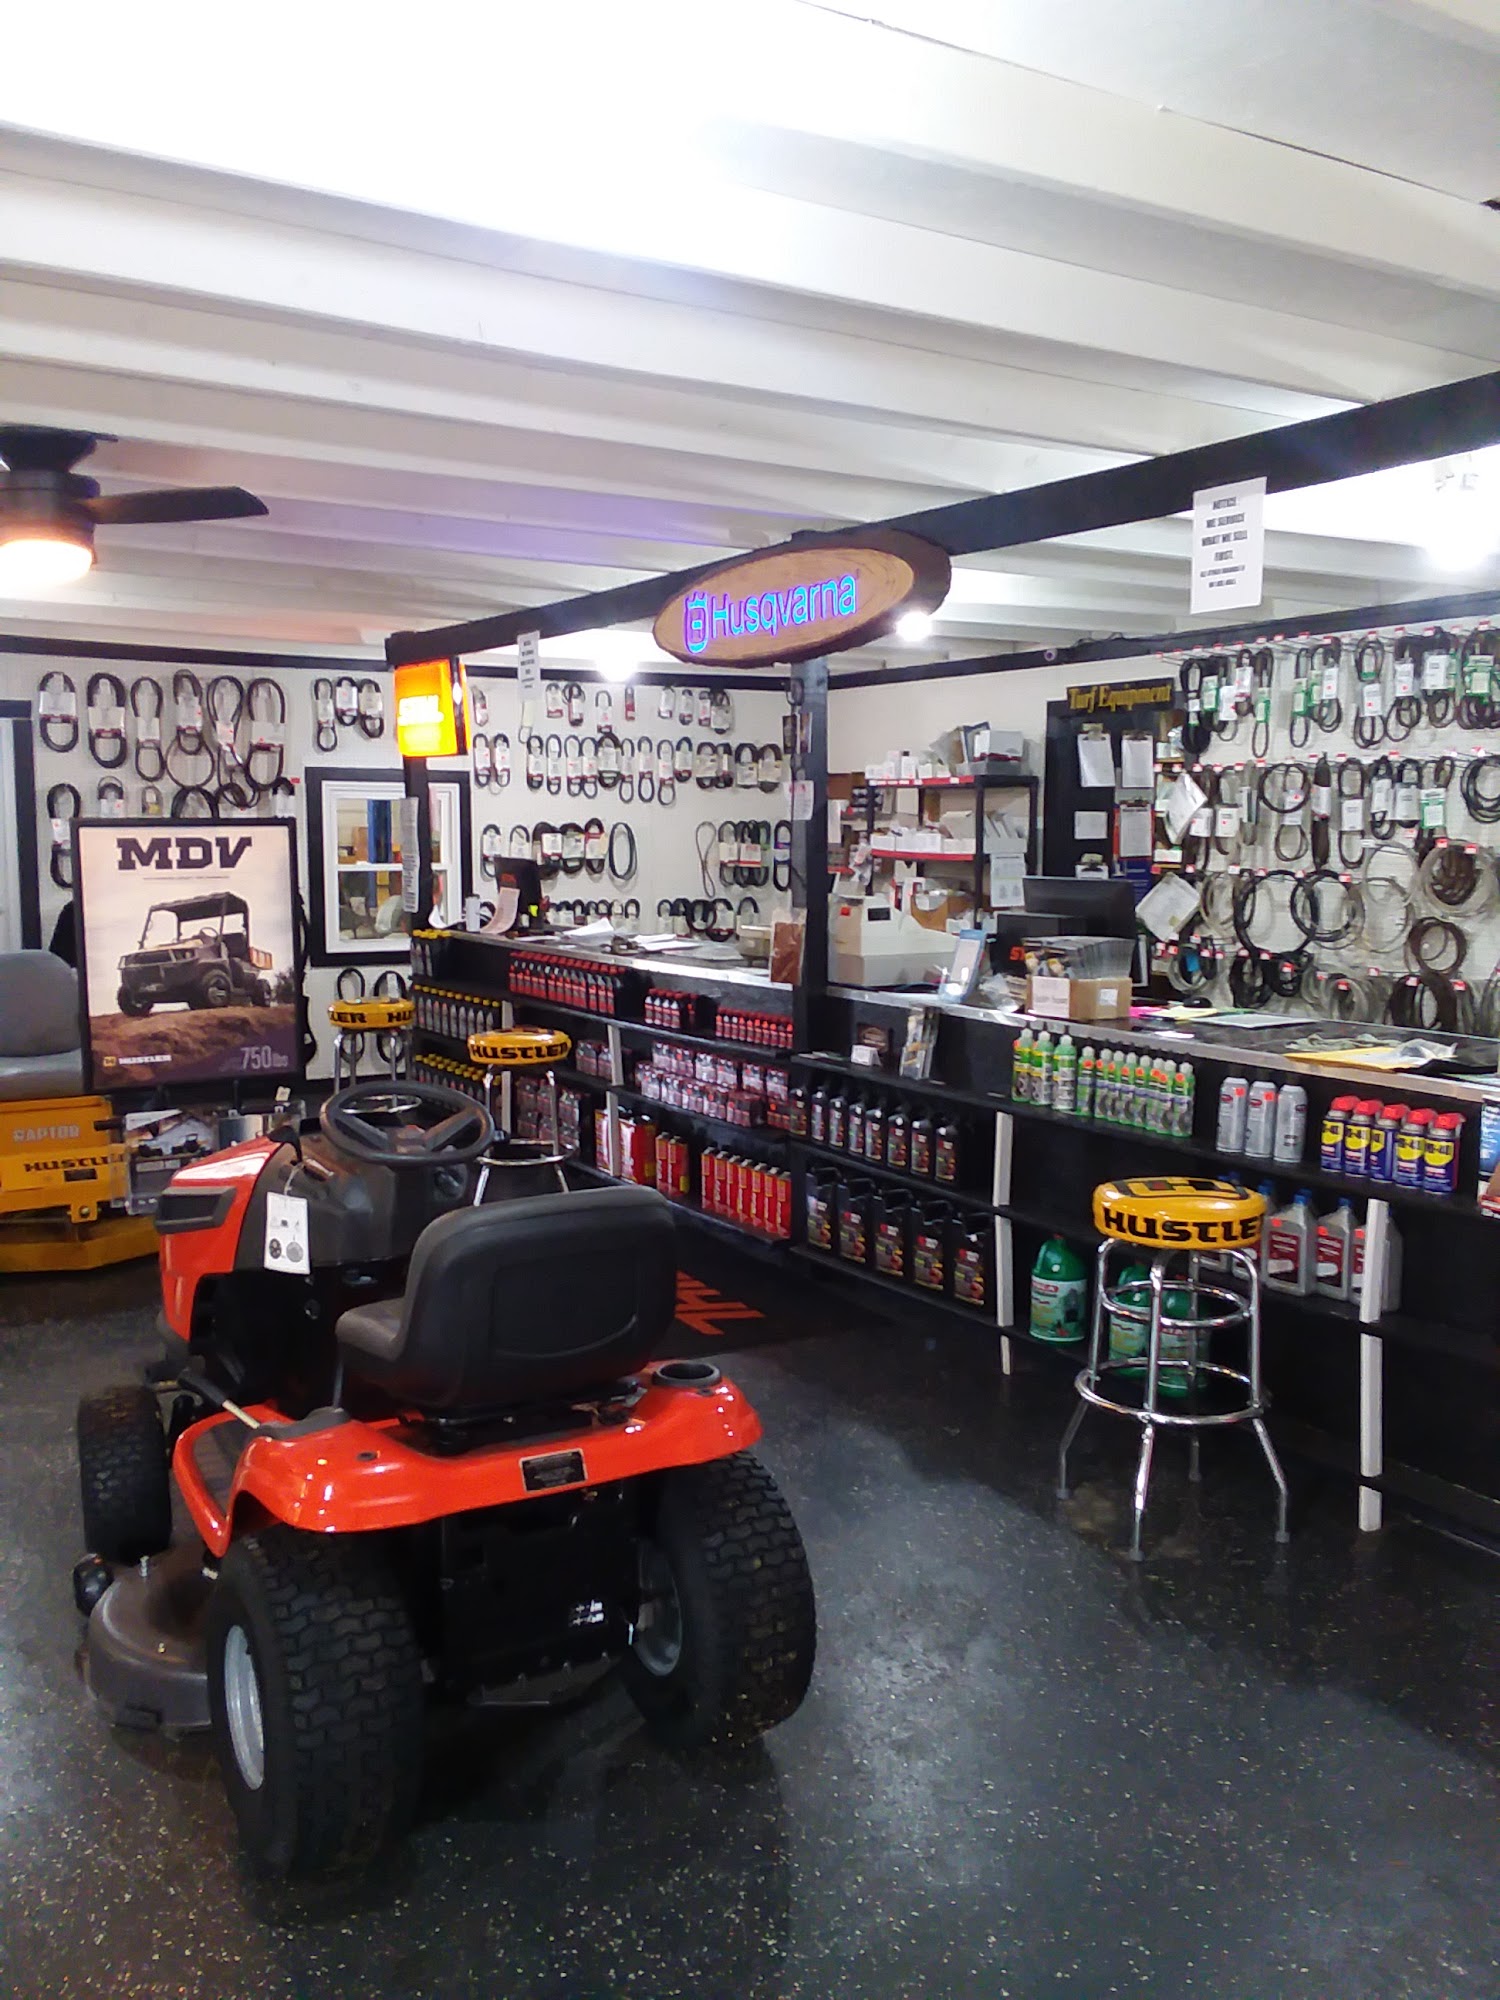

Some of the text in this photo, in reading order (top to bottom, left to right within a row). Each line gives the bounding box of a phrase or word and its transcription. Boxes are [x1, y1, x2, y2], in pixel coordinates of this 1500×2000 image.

[711, 574, 856, 639] Husqvarna
[1068, 683, 1171, 713] Turf Equipment
[116, 836, 252, 870] MDV
[470, 1042, 568, 1059] HUSTLER
[12, 1125, 80, 1143] RAPTOR
